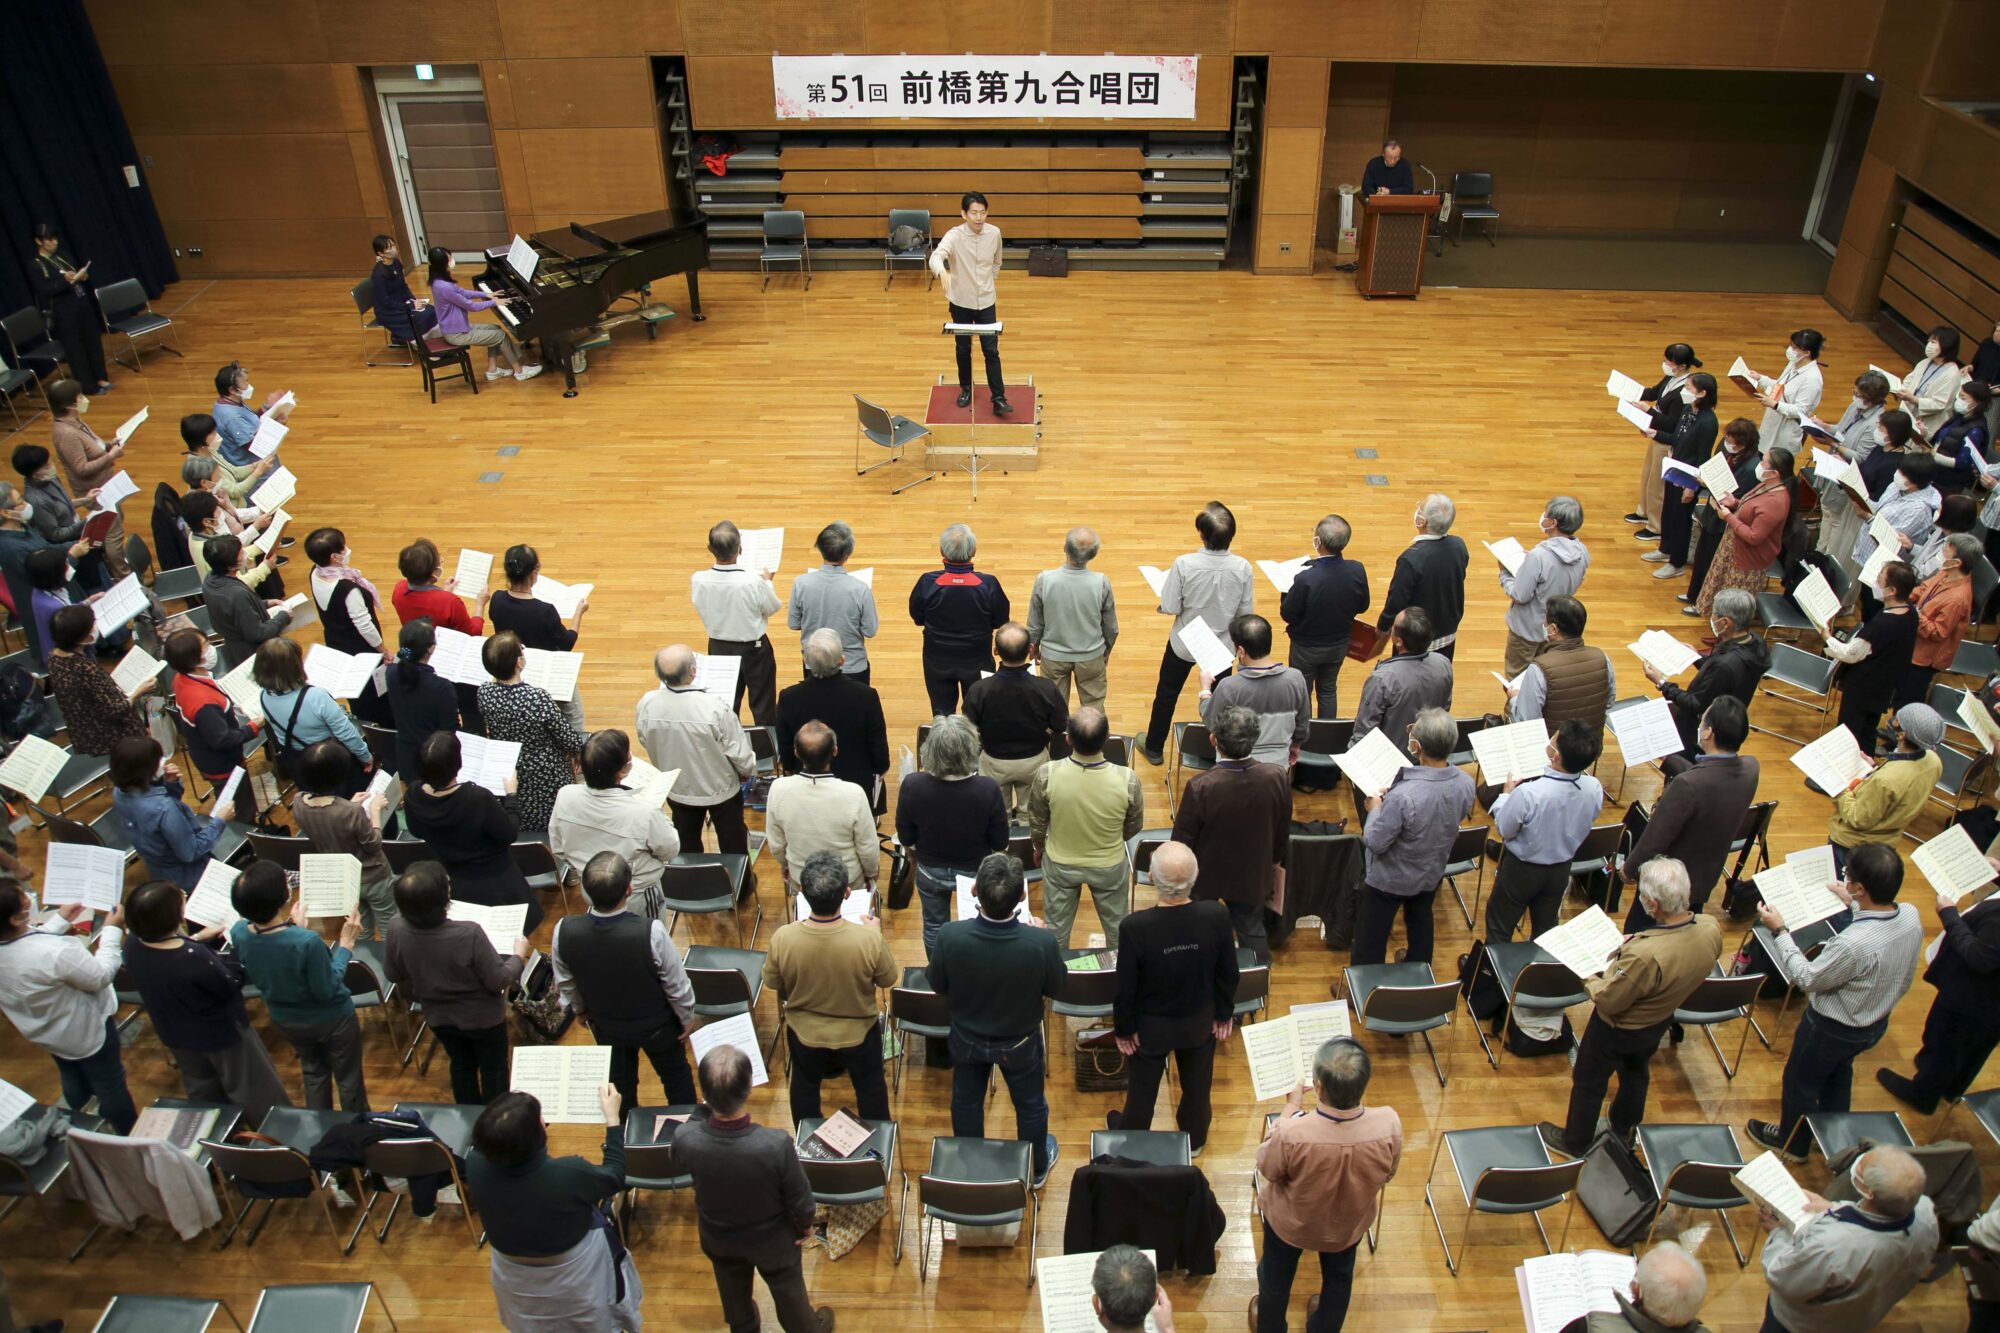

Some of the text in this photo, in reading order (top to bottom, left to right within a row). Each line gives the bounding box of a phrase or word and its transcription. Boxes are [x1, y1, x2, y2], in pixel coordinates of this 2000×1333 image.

[806, 70, 1160, 105] 第51回 前橋第九合唱団
[1163, 944, 1199, 954] ESPERANTO
